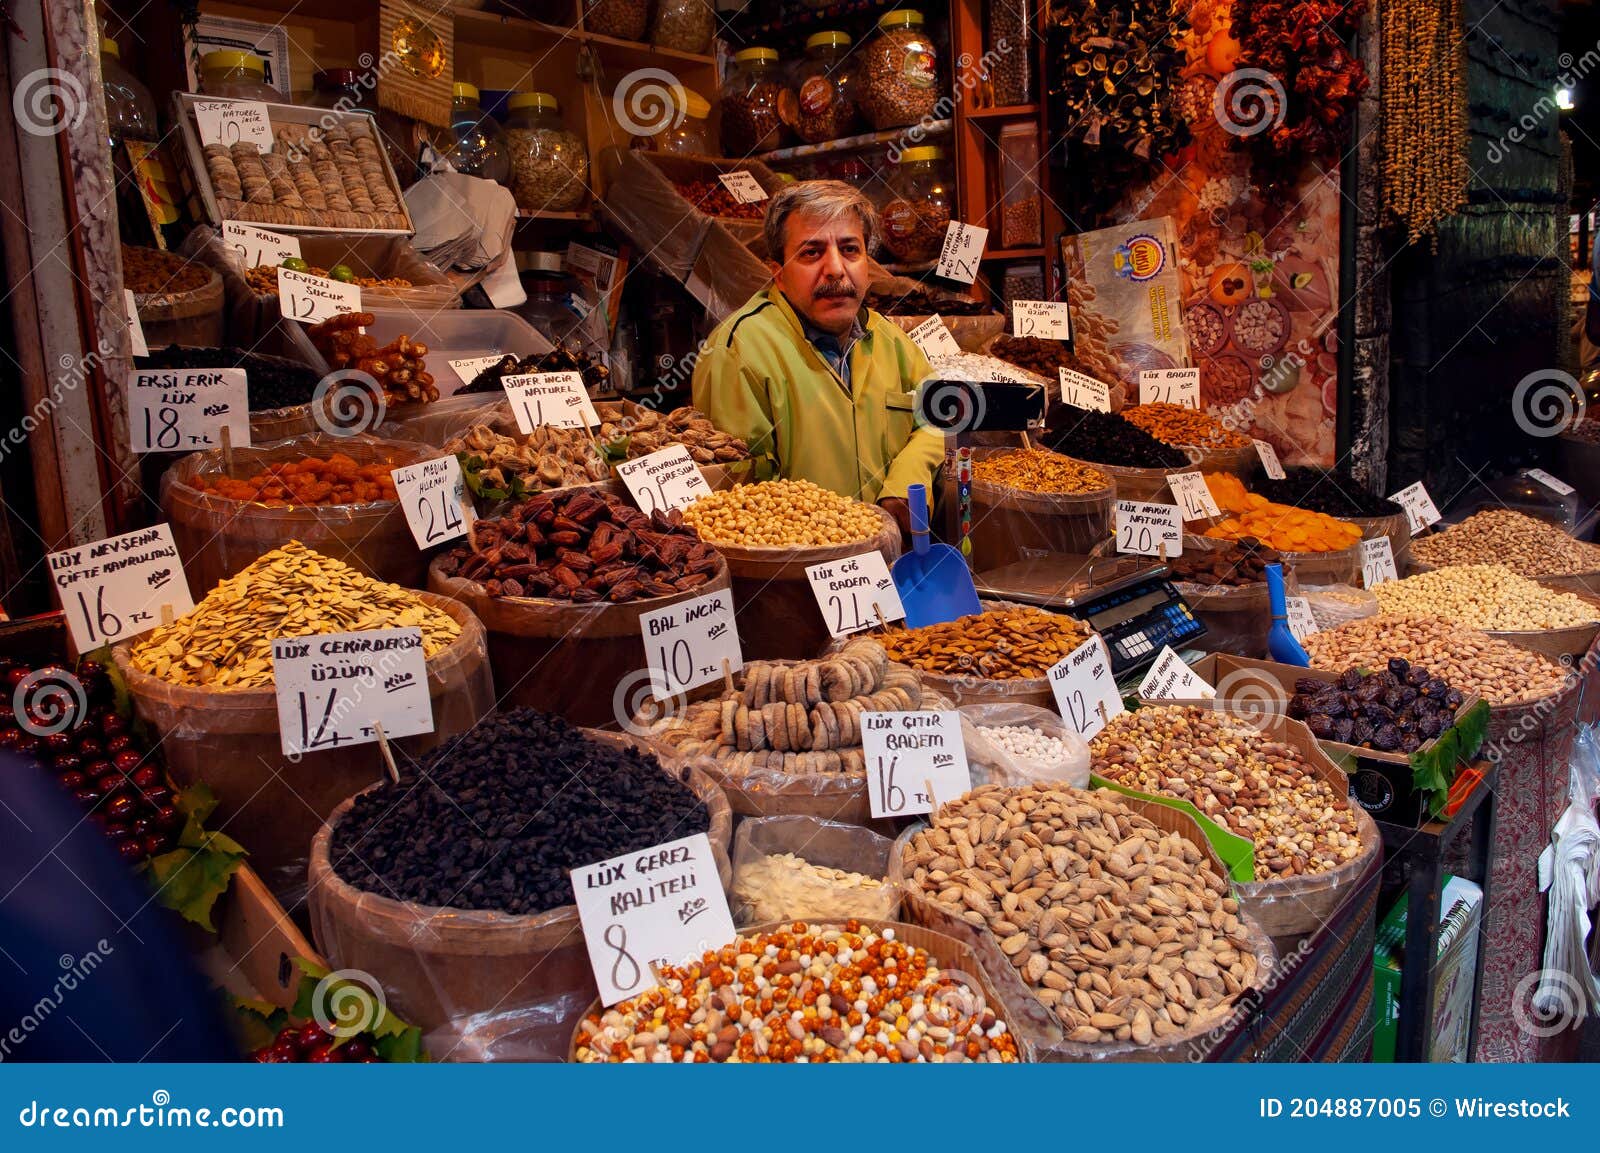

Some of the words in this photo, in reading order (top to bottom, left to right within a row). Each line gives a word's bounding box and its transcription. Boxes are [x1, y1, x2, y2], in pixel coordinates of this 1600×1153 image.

[291, 294, 319, 319] 12
[1020, 317, 1036, 335] 12
[505, 375, 541, 388] SÜPER
[525, 386, 577, 397] NATUREL
[161, 390, 196, 404] LÜX
[144, 407, 180, 448] 18
[418, 491, 462, 543] 24
[1120, 502, 1136, 513] LÜX
[1129, 515, 1176, 528] NATUREL
[1122, 525, 1152, 552] 20
[52, 551, 82, 570] LÜX
[813, 566, 834, 580] LÜX
[829, 576, 871, 591] BADEM
[77, 585, 122, 642] 16
[829, 593, 874, 633] 24
[649, 616, 680, 636] BAL
[275, 640, 310, 659] LÜX
[311, 660, 374, 681] ÜZÜM
[660, 639, 693, 691] 10
[1054, 664, 1071, 680] LÜX
[299, 688, 353, 749] 14
[867, 714, 893, 730] LÜX
[1066, 690, 1094, 734] 12
[886, 734, 944, 750] BADEM
[878, 756, 906, 812] 16
[587, 863, 626, 889] LÜX
[604, 924, 641, 991] 8
